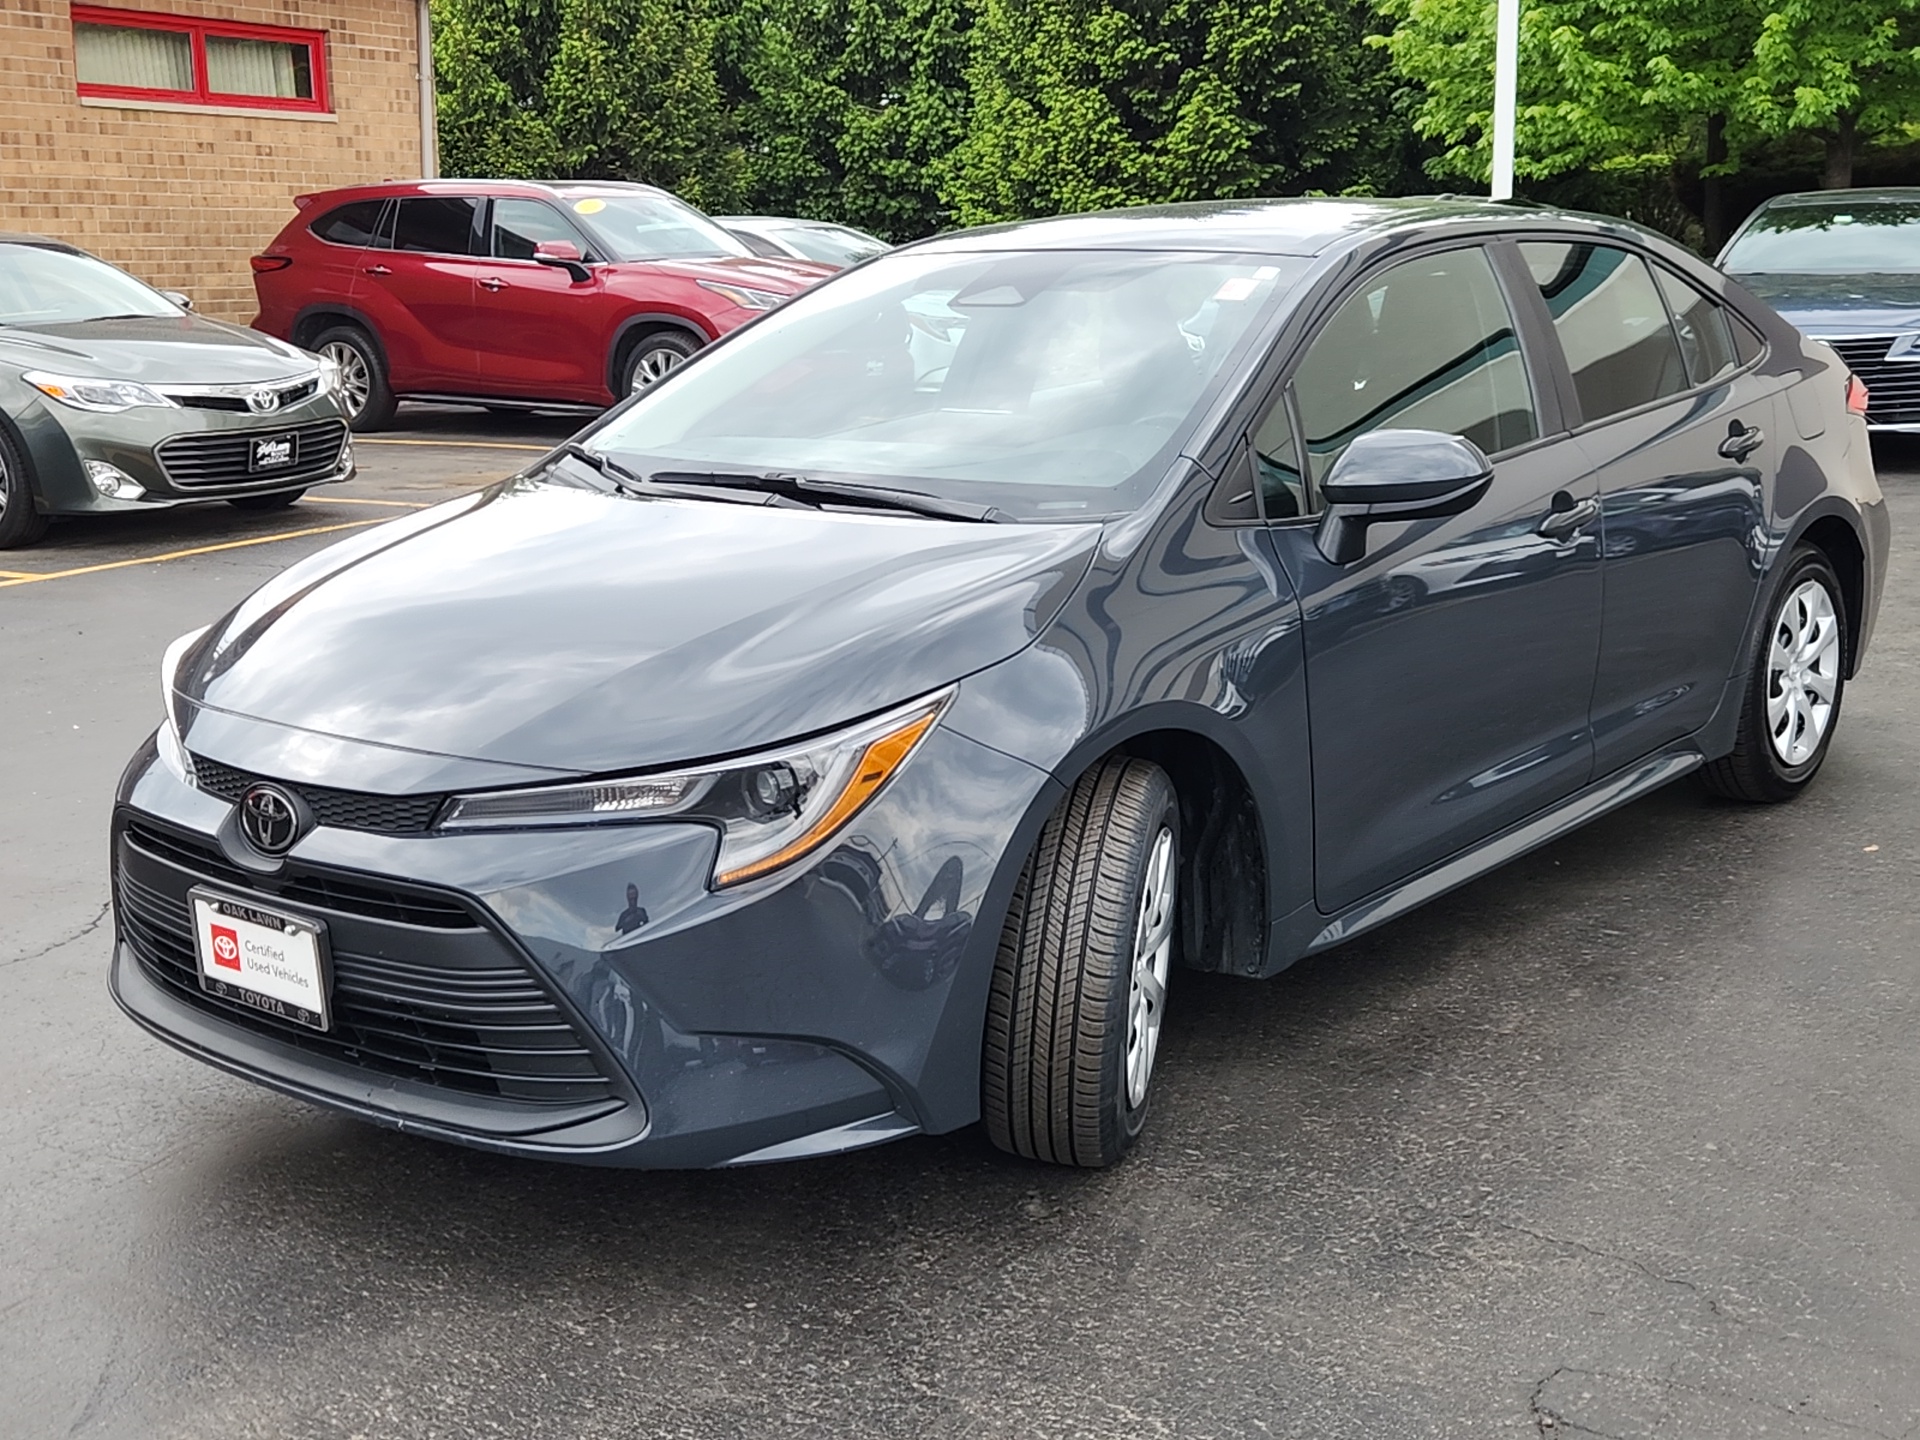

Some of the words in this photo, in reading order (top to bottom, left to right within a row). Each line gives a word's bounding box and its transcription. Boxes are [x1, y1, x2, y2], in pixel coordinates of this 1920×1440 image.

[222, 903, 248, 920] OAK
[250, 911, 282, 930] LAWN
[245, 940, 285, 962] Certified
[247, 958, 270, 975] Used
[271, 965, 309, 988] Vehicles
[238, 988, 285, 1015] TOYOTA
